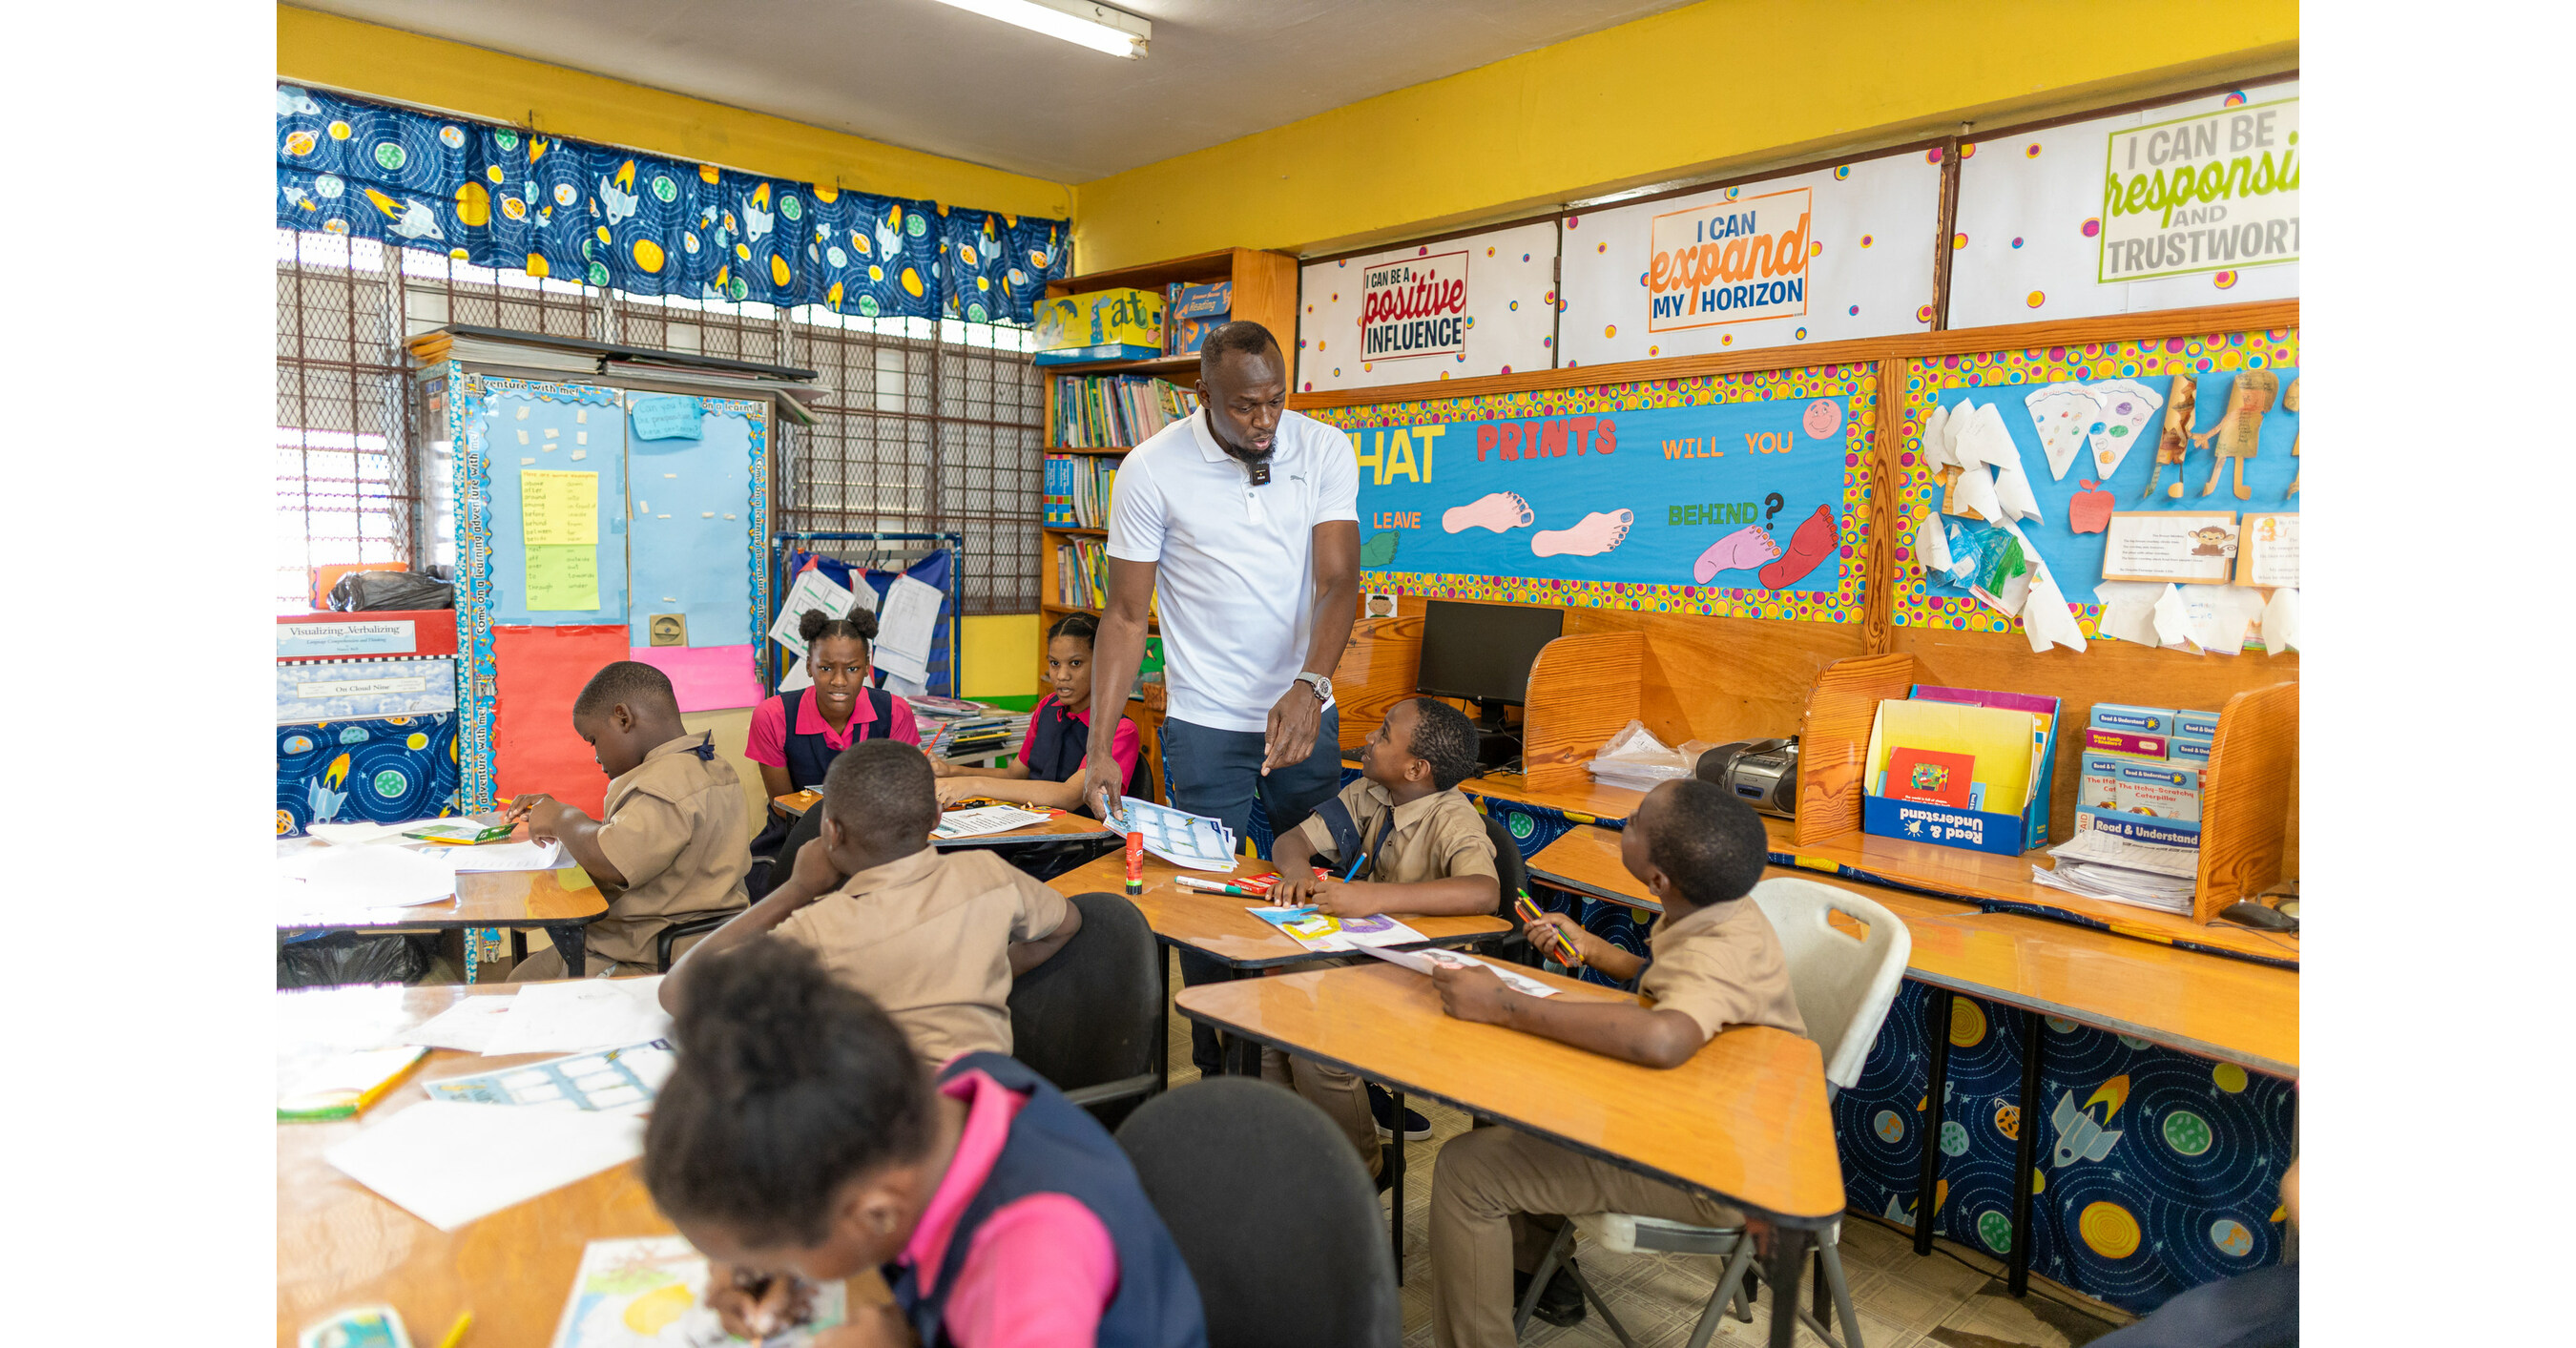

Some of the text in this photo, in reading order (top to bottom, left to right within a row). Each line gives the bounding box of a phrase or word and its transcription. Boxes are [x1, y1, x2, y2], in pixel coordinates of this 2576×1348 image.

[2128, 110, 2277, 170] I CAN BE
[1697, 210, 1756, 242] I CAN
[2172, 205, 2228, 227] AND
[1651, 212, 1810, 316] expand
[1365, 267, 1410, 288] I CAN BE A
[1362, 268, 1466, 329] positive
[1653, 278, 1803, 319] MY HORIZON
[1111, 292, 1148, 329] at
[1367, 317, 1463, 354] INFLUENCE
[531, 383, 558, 393] with
[560, 386, 579, 395] me!
[1345, 416, 1793, 486] HAT PRINTS WILL YOU
[469, 453, 479, 476] with
[755, 486, 760, 497] on
[471, 480, 482, 532] adventure
[755, 508, 763, 546] learning
[1374, 511, 1422, 529] LEAVE
[475, 536, 484, 577] learning
[756, 549, 764, 595] adventure
[478, 581, 485, 590] a
[478, 592, 485, 604] on
[289, 625, 401, 637] Visualizing Verbalizing
[477, 607, 486, 634] Come
[478, 707, 487, 724] me!
[2118, 717, 2145, 725] Understand
[477, 727, 486, 751] with
[478, 754, 488, 804] adventure
[2143, 771, 2171, 780] Understand
[2134, 785, 2194, 798] Itchy-Scratchy
[2135, 792, 2177, 802] Caterpillar
[1900, 808, 1983, 831] Understand
[1930, 825, 1983, 845] Read &
[2096, 820, 2122, 833] Read
[2124, 824, 2133, 835] &
[2136, 827, 2198, 845] Understand
